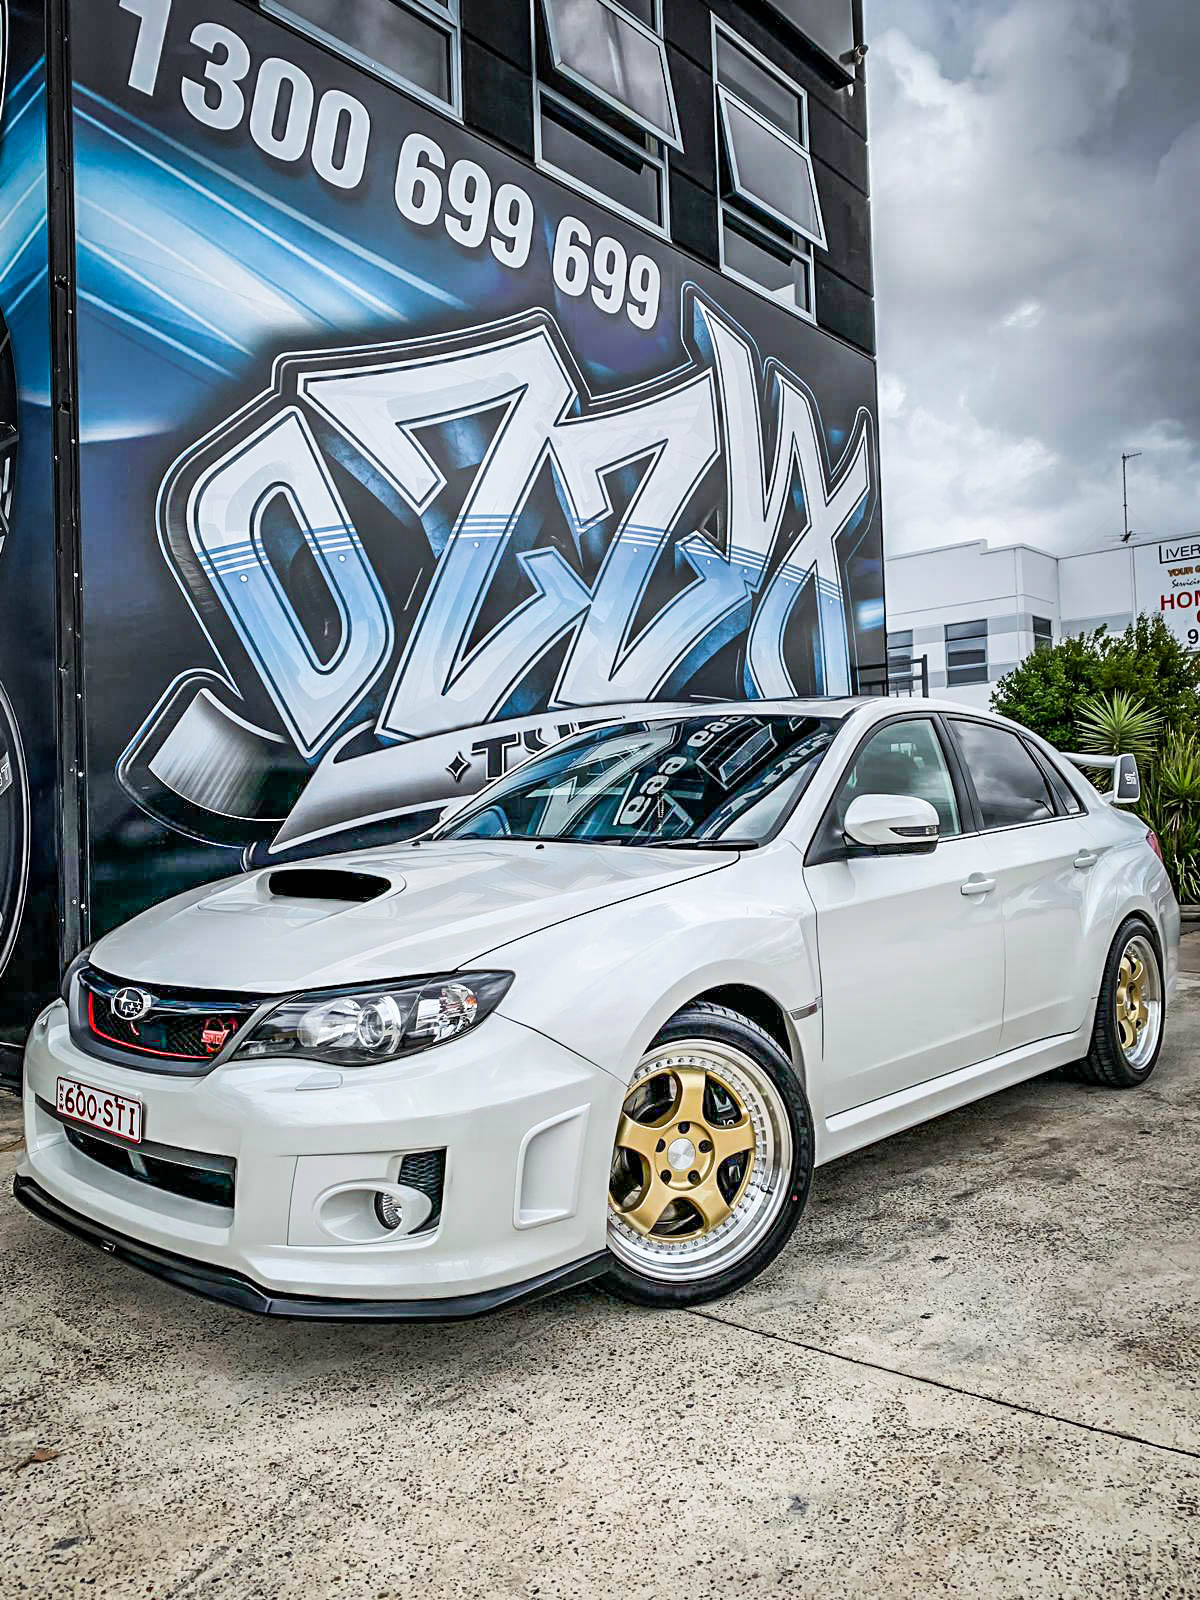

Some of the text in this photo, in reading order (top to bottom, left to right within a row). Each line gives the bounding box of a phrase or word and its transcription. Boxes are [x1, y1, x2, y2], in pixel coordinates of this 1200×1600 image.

[118, 0, 661, 331] 1300 699 699
[1167, 566, 1194, 577] YOUR
[1187, 628, 1199, 645] 9
